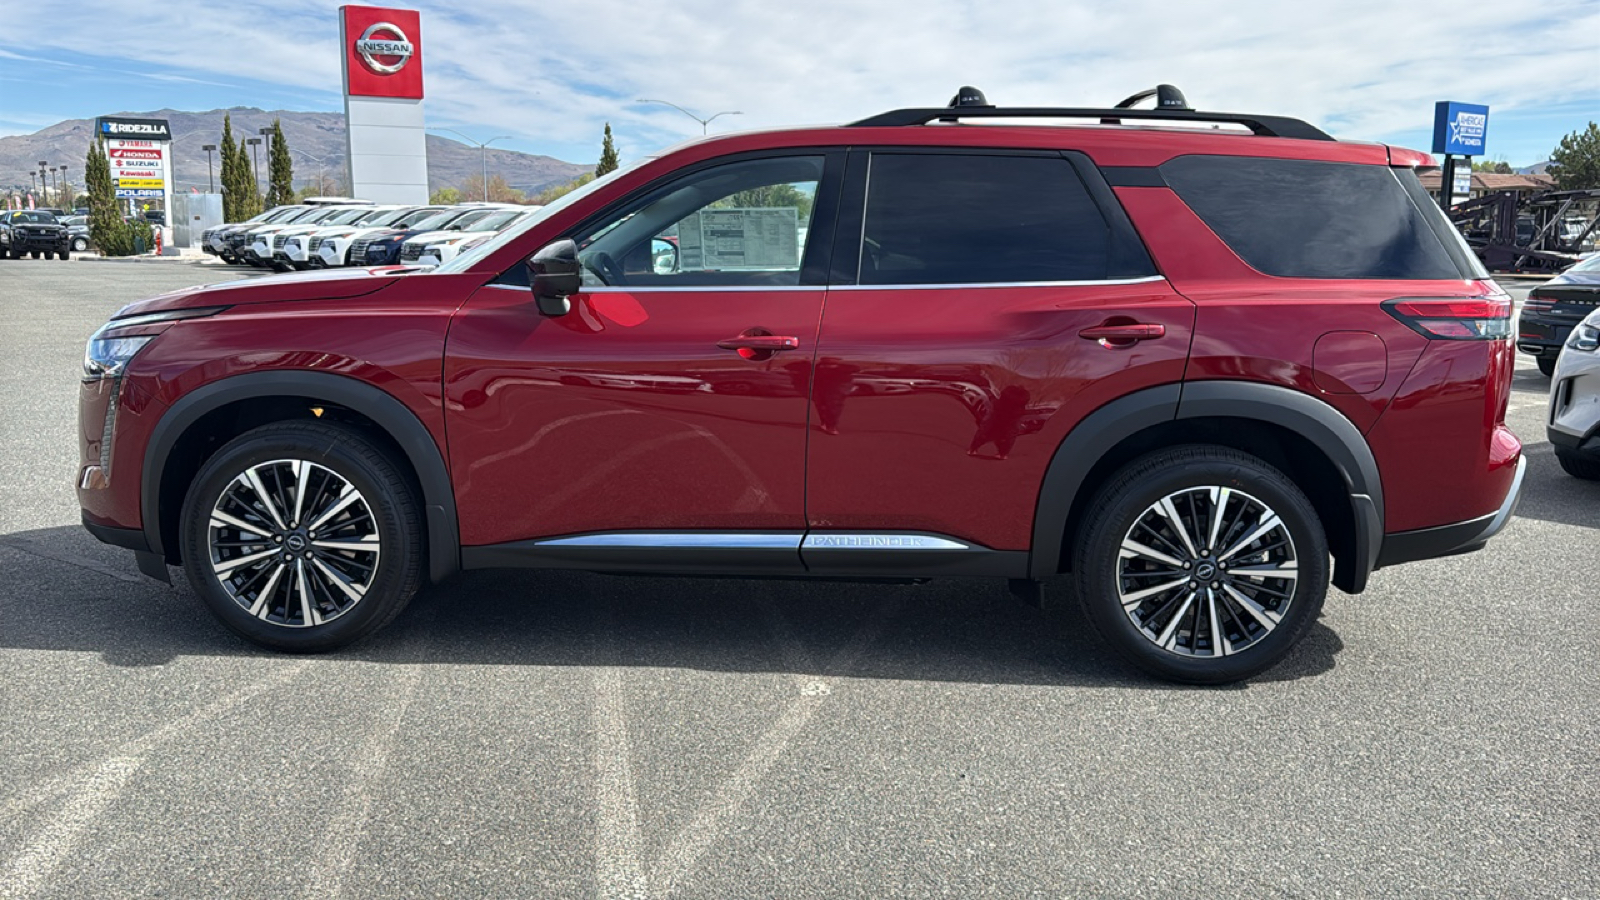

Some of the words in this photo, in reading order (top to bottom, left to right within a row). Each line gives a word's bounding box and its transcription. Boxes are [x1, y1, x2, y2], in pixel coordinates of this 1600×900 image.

[363, 42, 409, 52] NISSAN
[118, 124, 167, 134] RIDEZILLA
[811, 536, 924, 547] PATHFINDER
